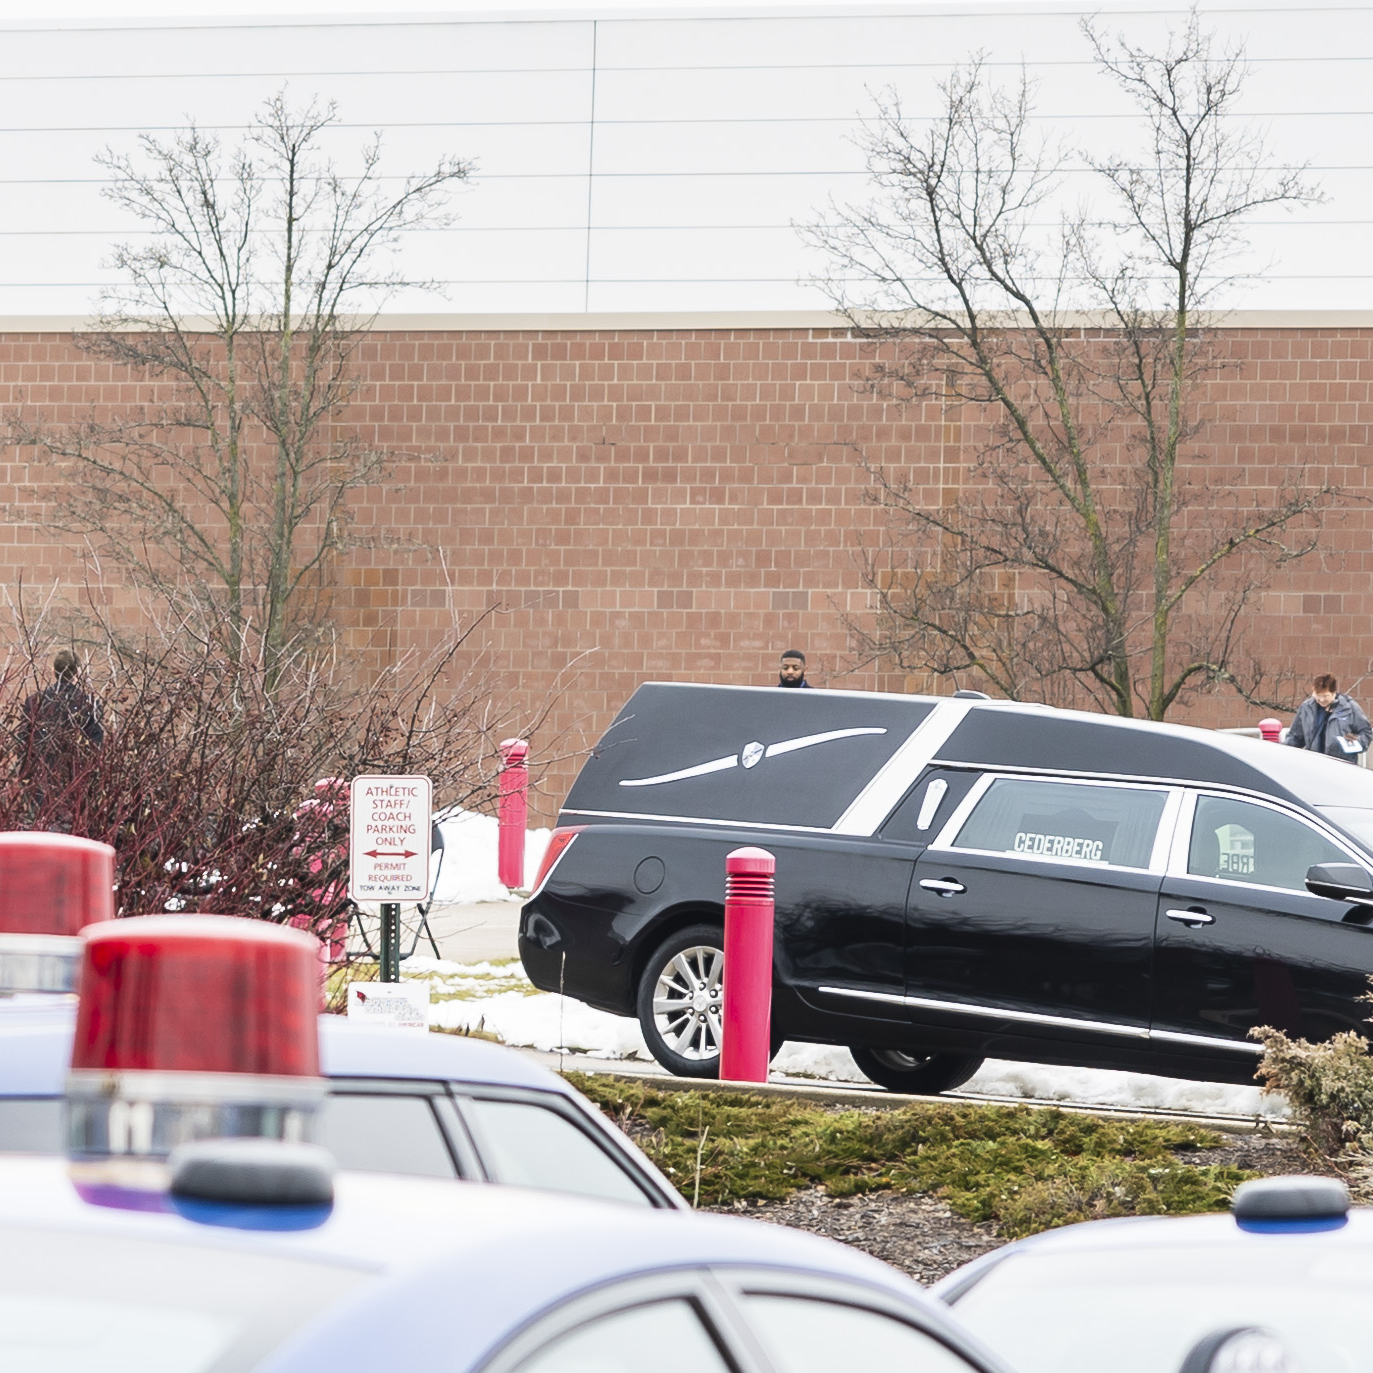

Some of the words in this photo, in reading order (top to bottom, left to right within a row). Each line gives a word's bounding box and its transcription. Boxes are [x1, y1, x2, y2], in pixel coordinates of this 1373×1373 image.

[365, 786, 418, 797] ATHLETIC
[372, 799, 410, 809] STAFF/
[371, 812, 412, 822] COACH
[366, 824, 417, 834] PARKING
[375, 837, 406, 847] ONLY
[1013, 832, 1104, 861] CEDERBERG
[373, 862, 407, 871] PERMIT
[368, 875, 412, 883] REQUIRED
